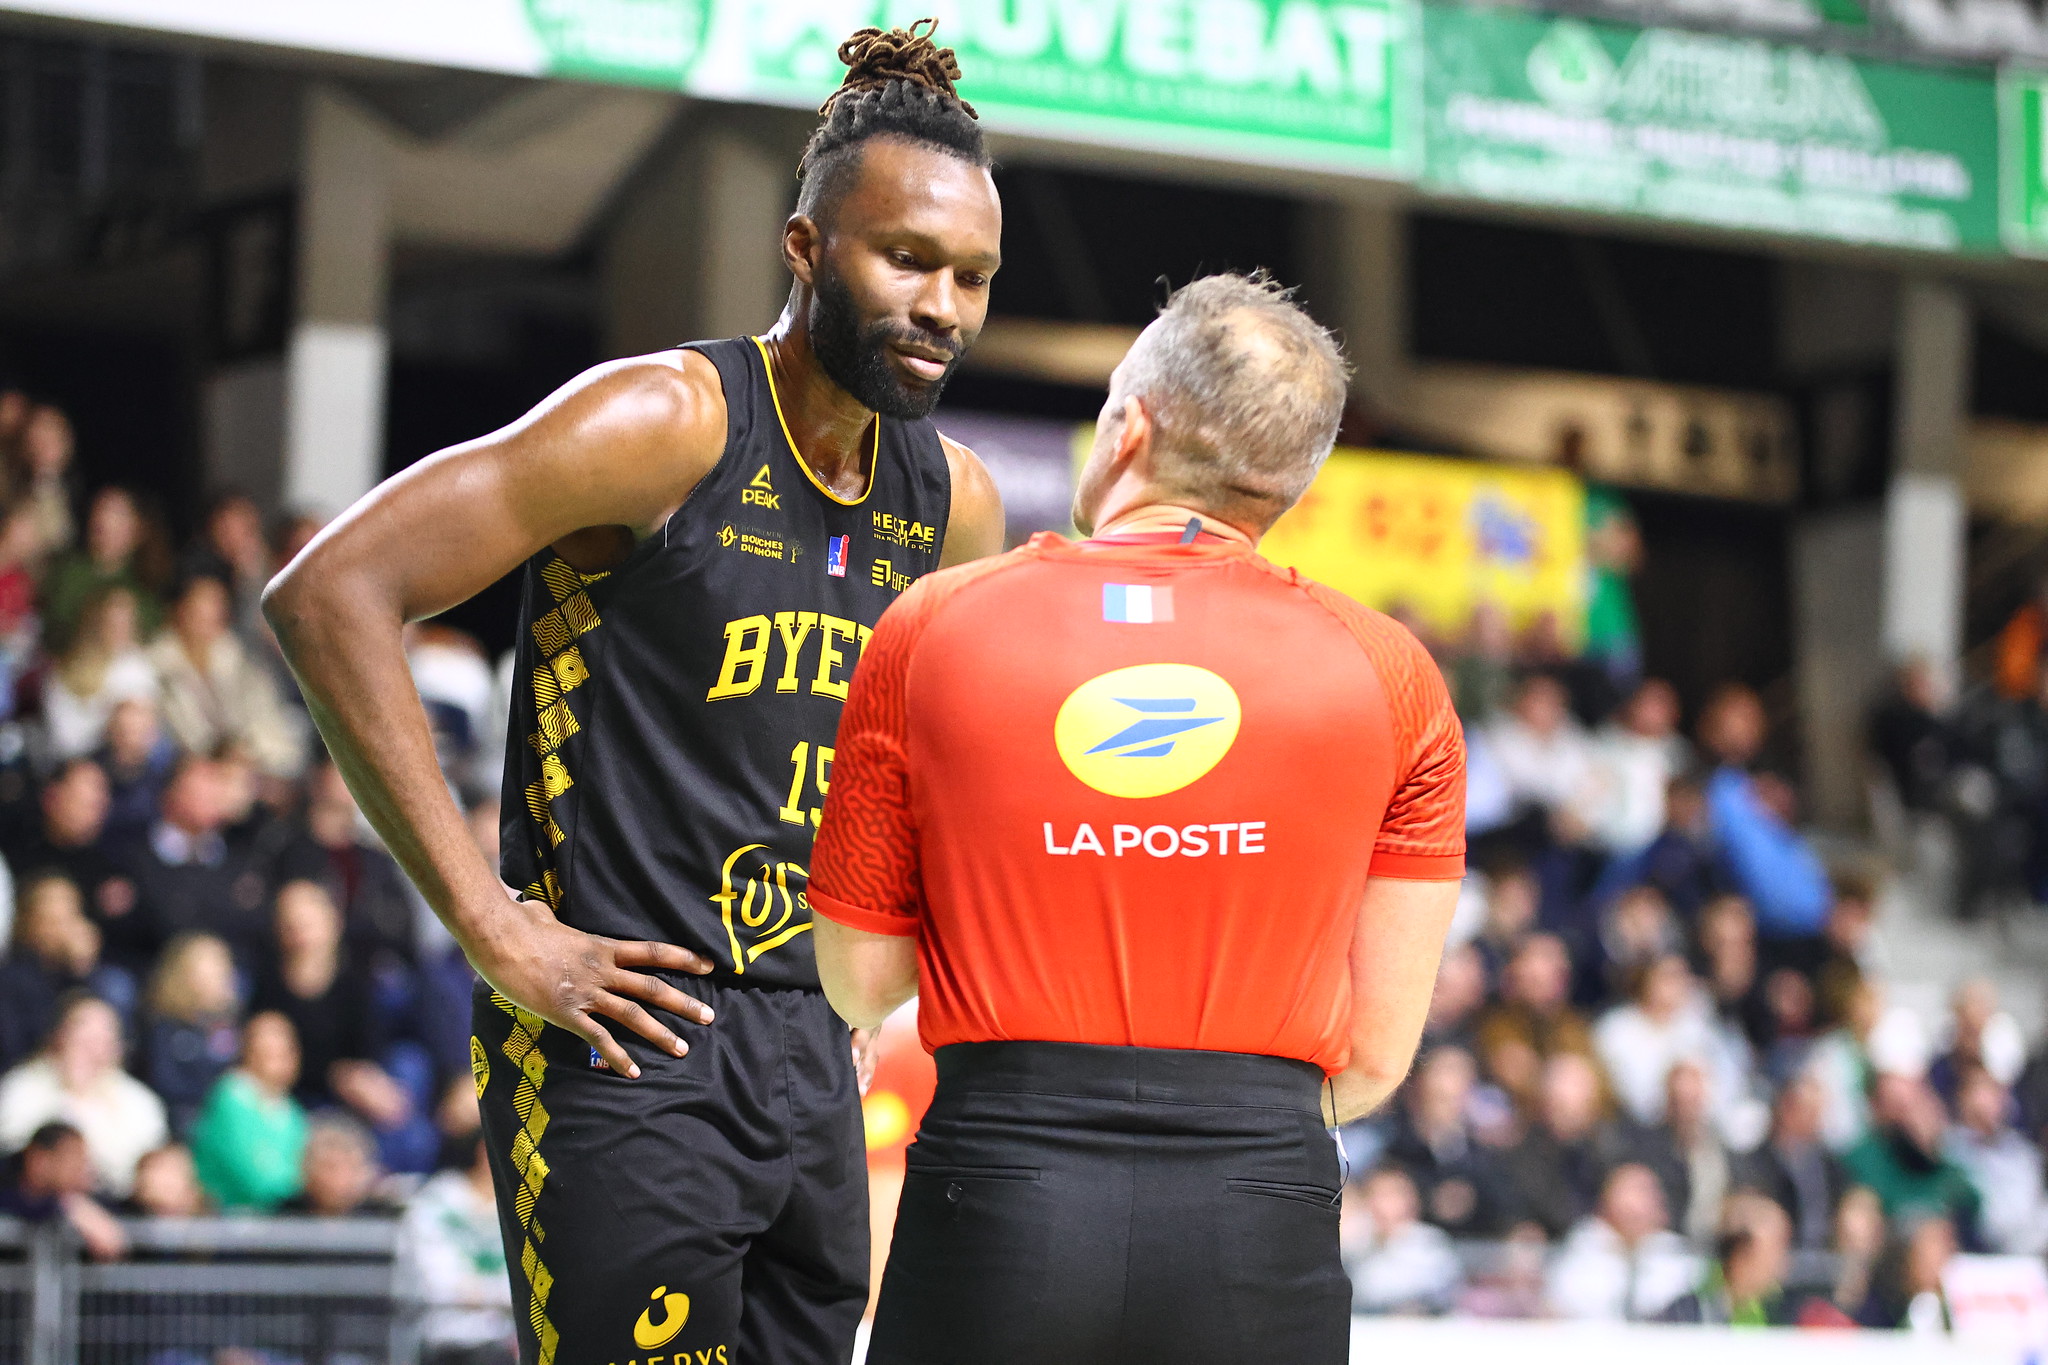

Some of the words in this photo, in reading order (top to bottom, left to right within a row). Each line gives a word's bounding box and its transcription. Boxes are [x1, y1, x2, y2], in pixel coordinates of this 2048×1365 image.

[742, 488, 780, 510] PEAK
[740, 543, 754, 553] DU
[754, 547, 783, 560] RHÔNE
[741, 534, 784, 550] BOUCHES
[828, 563, 845, 576] LNB
[892, 571, 919, 592] EIFF
[706, 611, 874, 702] BYE
[1043, 822, 1106, 857] LA
[1113, 821, 1266, 858] POSTE
